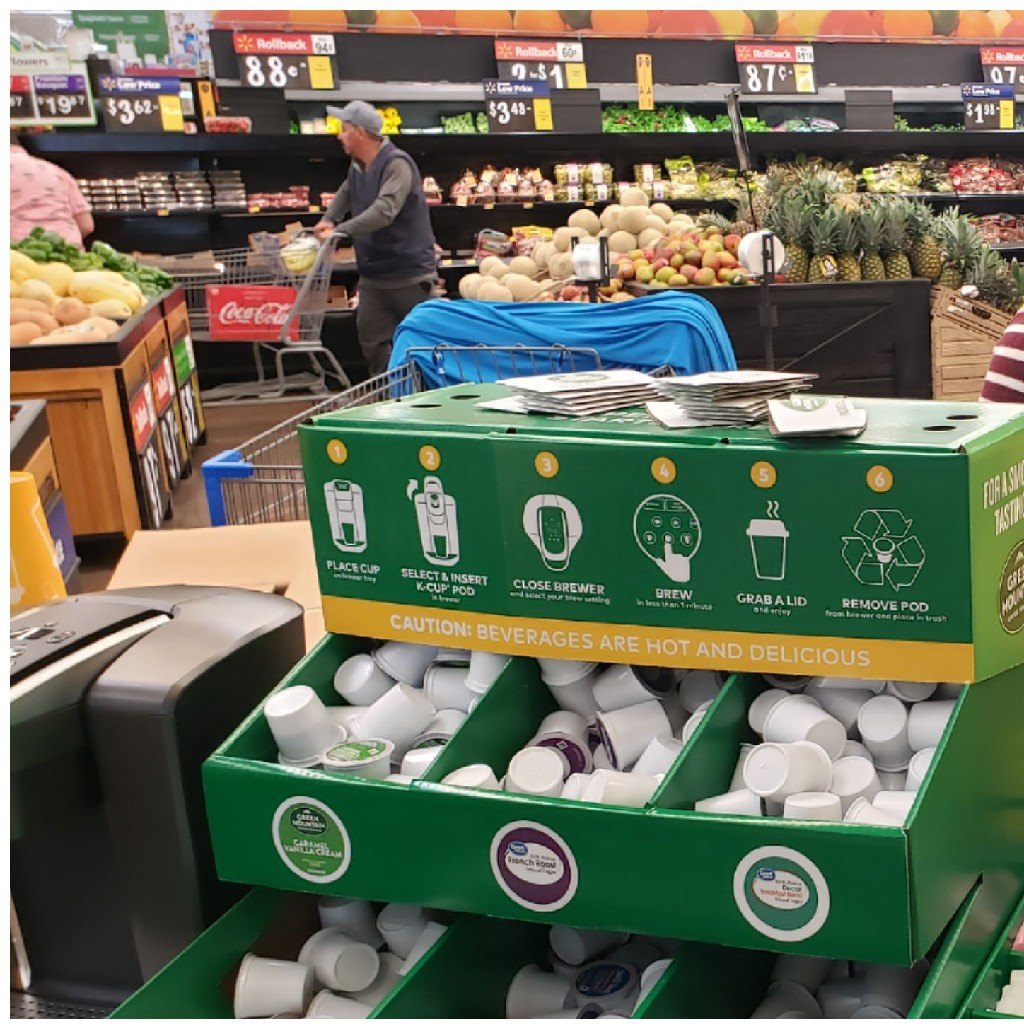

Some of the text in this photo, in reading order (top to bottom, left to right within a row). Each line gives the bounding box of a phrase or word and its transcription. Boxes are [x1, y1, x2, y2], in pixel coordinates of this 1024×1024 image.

[257, 37, 307, 51] Rollback
[753, 48, 791, 59] Rollback
[138, 81, 161, 91] Price
[334, 445, 342, 459] 1
[425, 451, 435, 465] 2
[542, 457, 552, 472] 3
[658, 463, 669, 478] 4
[759, 468, 770, 483] 5
[874, 472, 886, 488] 6
[983, 475, 1000, 511] FOR
[326, 560, 381, 575] PLACE CUP
[401, 568, 488, 586] SELECT & INSERT
[452, 584, 475, 596] POD
[512, 579, 606, 595] CLOSE BREWER
[655, 588, 694, 601] BREW
[736, 592, 808, 607] GRAB A LID
[841, 598, 930, 613] REMOVE POD
[770, 607, 791, 617] enjoy
[846, 609, 875, 619] brewer
[876, 611, 892, 620] and
[892, 612, 915, 621] place
[925, 613, 948, 623] trash
[389, 613, 872, 667] CAUTION: BEVERAGES ARE HOT AND DELICIOUS
